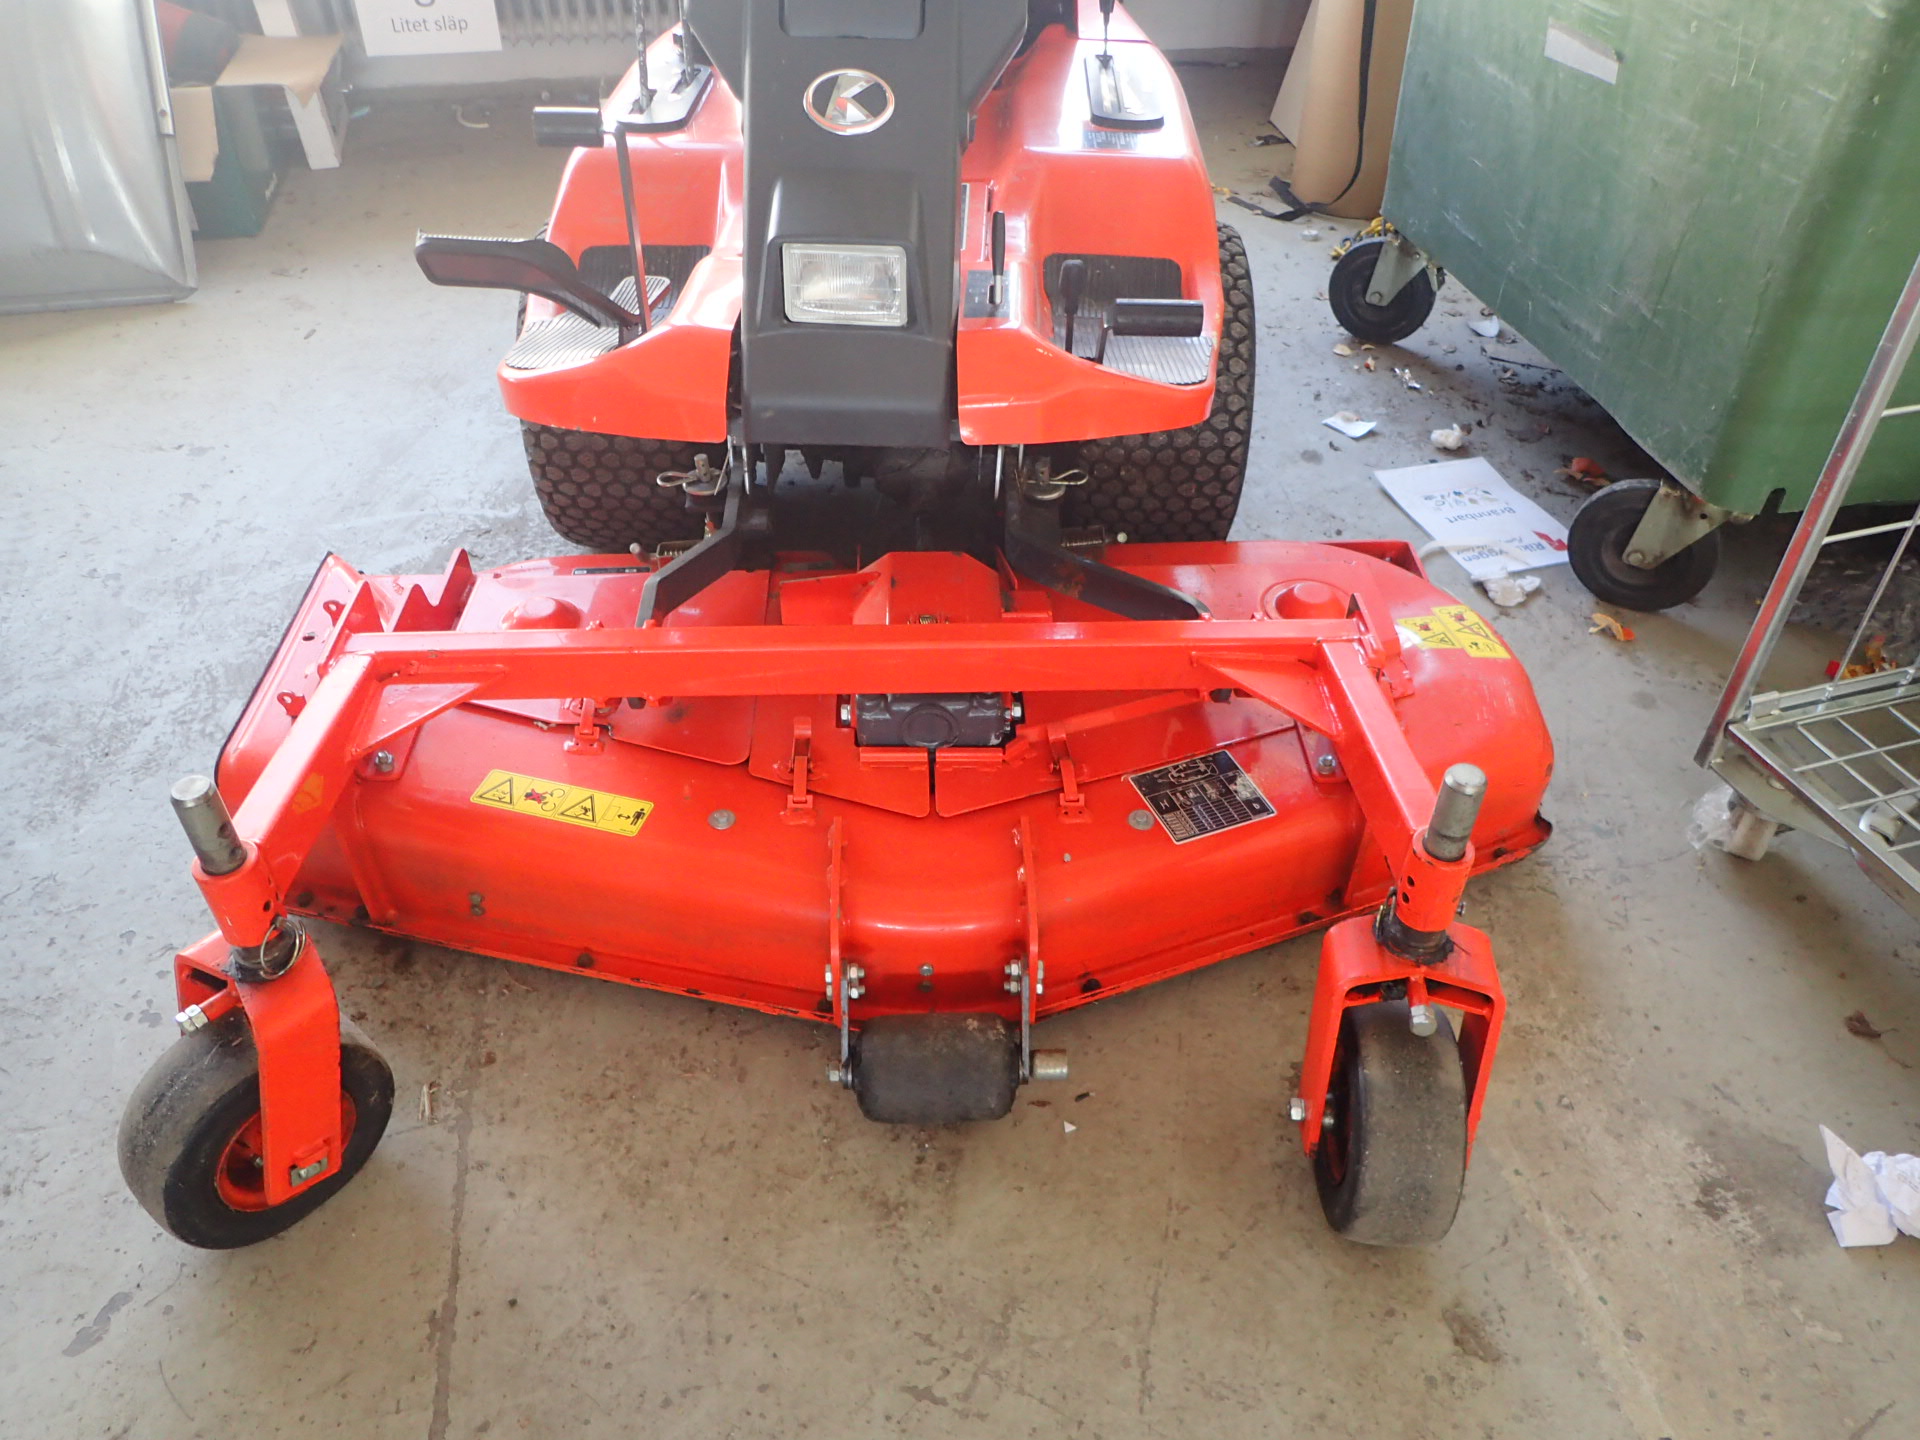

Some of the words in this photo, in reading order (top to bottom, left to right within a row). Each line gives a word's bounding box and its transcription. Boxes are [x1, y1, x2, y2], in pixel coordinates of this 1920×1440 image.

[391, 18, 430, 33] Litet
[434, 15, 468, 35] släp
[1445, 506, 1517, 524] Brännbart
